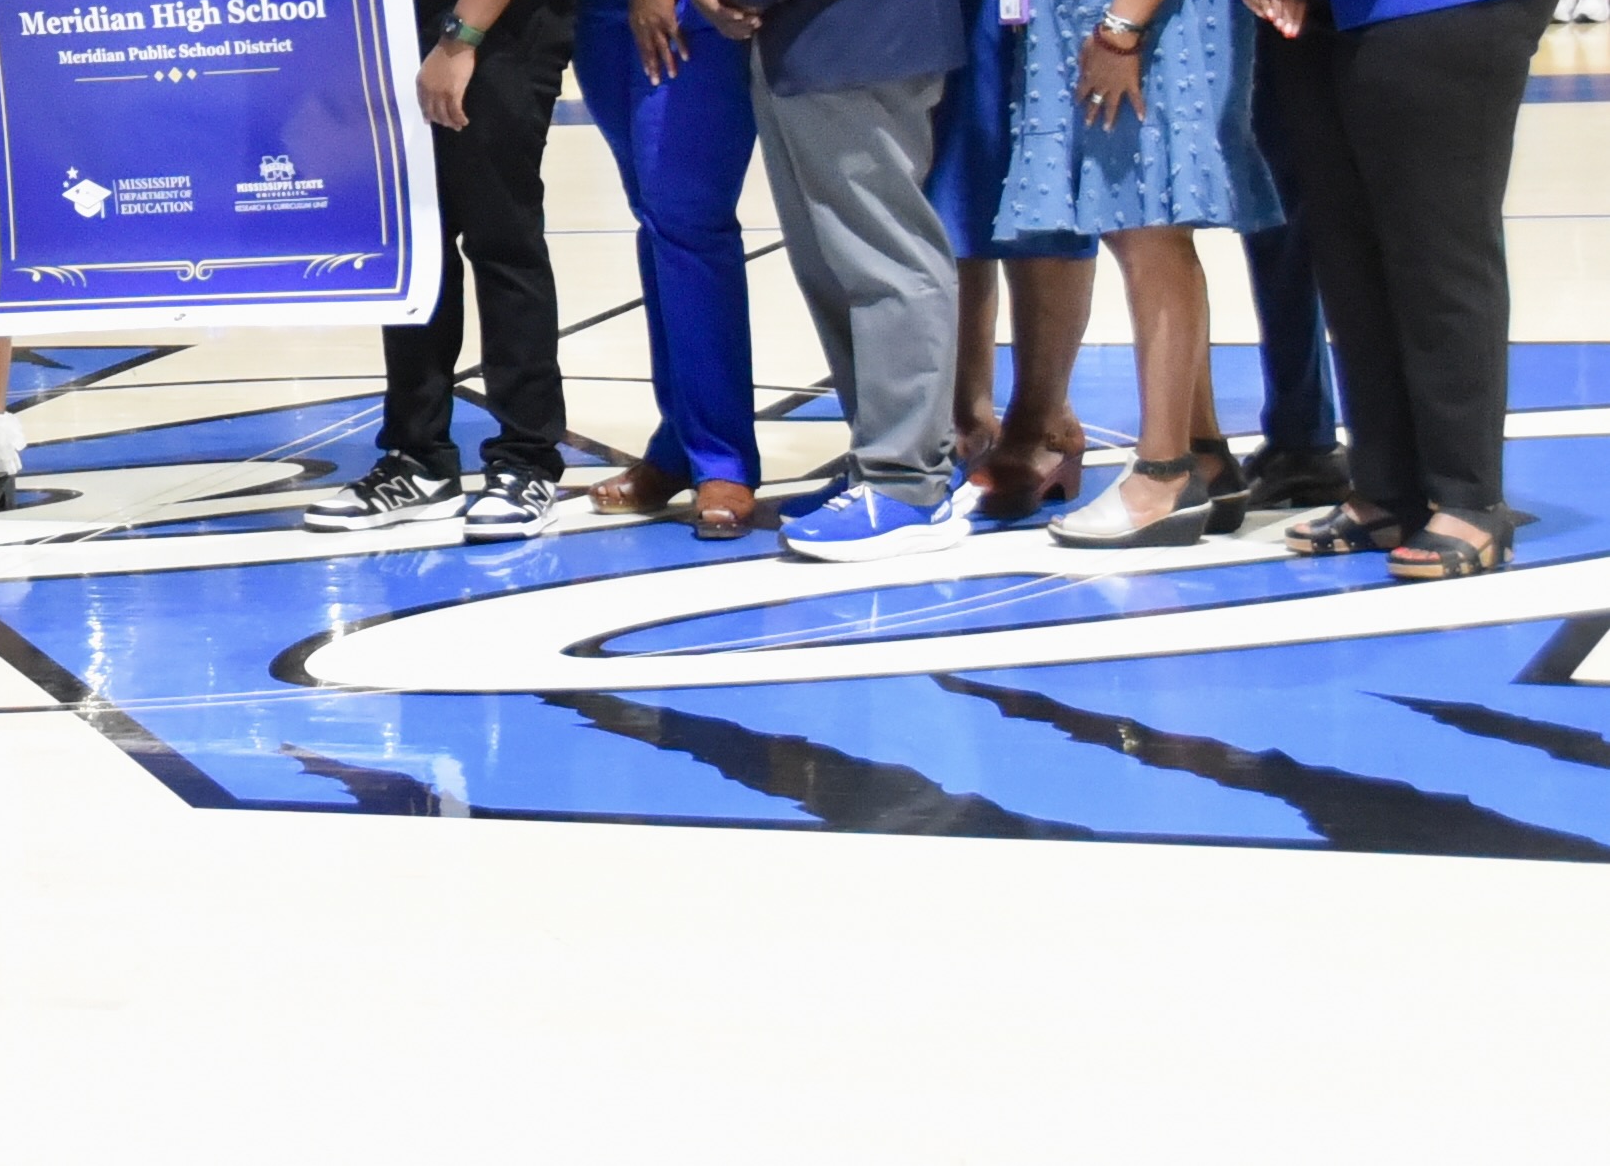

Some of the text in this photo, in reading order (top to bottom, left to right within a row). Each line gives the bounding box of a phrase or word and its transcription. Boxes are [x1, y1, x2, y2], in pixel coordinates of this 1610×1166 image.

[18, 5, 146, 36] Meridian
[150, 0, 222, 33] High
[57, 37, 294, 65] Meridian Public School District
[118, 175, 191, 190] MISSISSIPPI
[236, 178, 324, 193] MISSISSIPPI STATE
[119, 189, 193, 202] DEPARTMENT OF
[120, 200, 194, 215] EDUCATION
